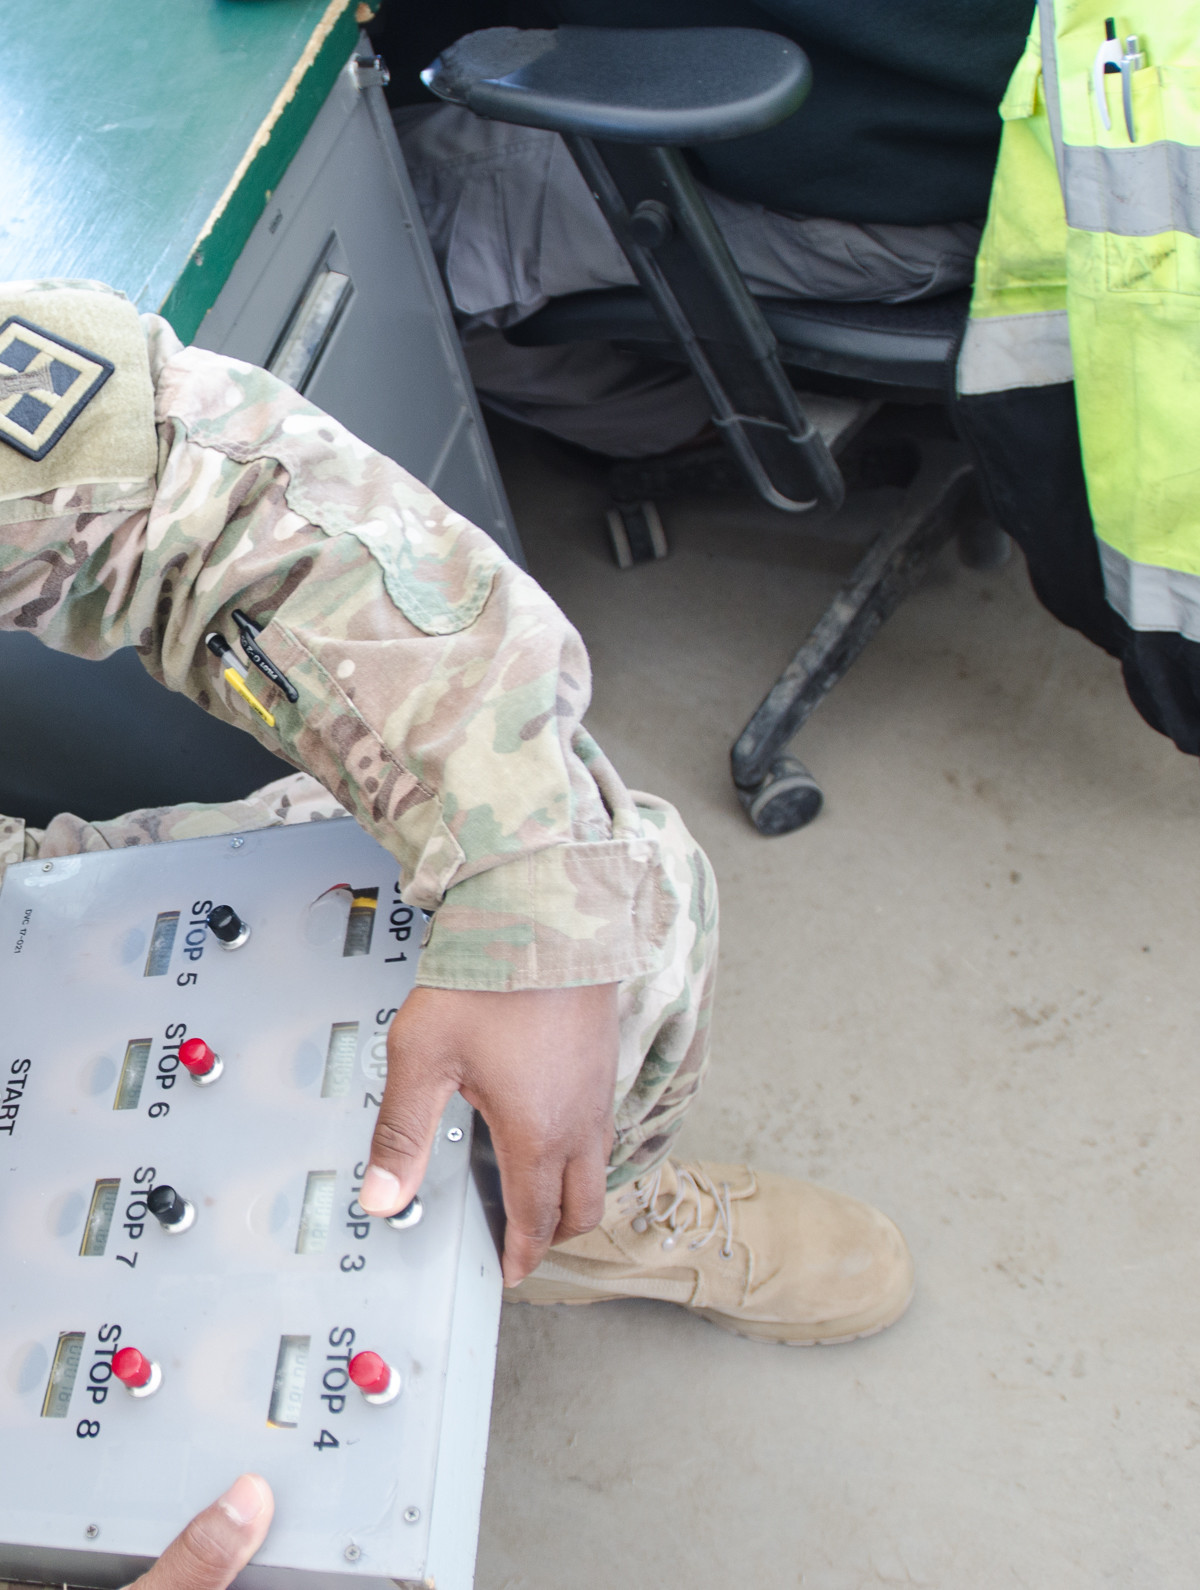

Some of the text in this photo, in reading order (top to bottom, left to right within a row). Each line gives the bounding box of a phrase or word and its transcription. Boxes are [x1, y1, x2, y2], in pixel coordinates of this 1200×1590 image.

[22, 909, 33, 926] DVC
[176, 900, 214, 988] STOP 5
[384, 952, 408, 964] 1
[148, 1023, 187, 1119] STOP 6
[115, 1166, 157, 1269] STOP 7
[339, 1254, 366, 1273] 3
[76, 1323, 122, 1439] STOP 8
[313, 1326, 356, 1452] STOP 4
